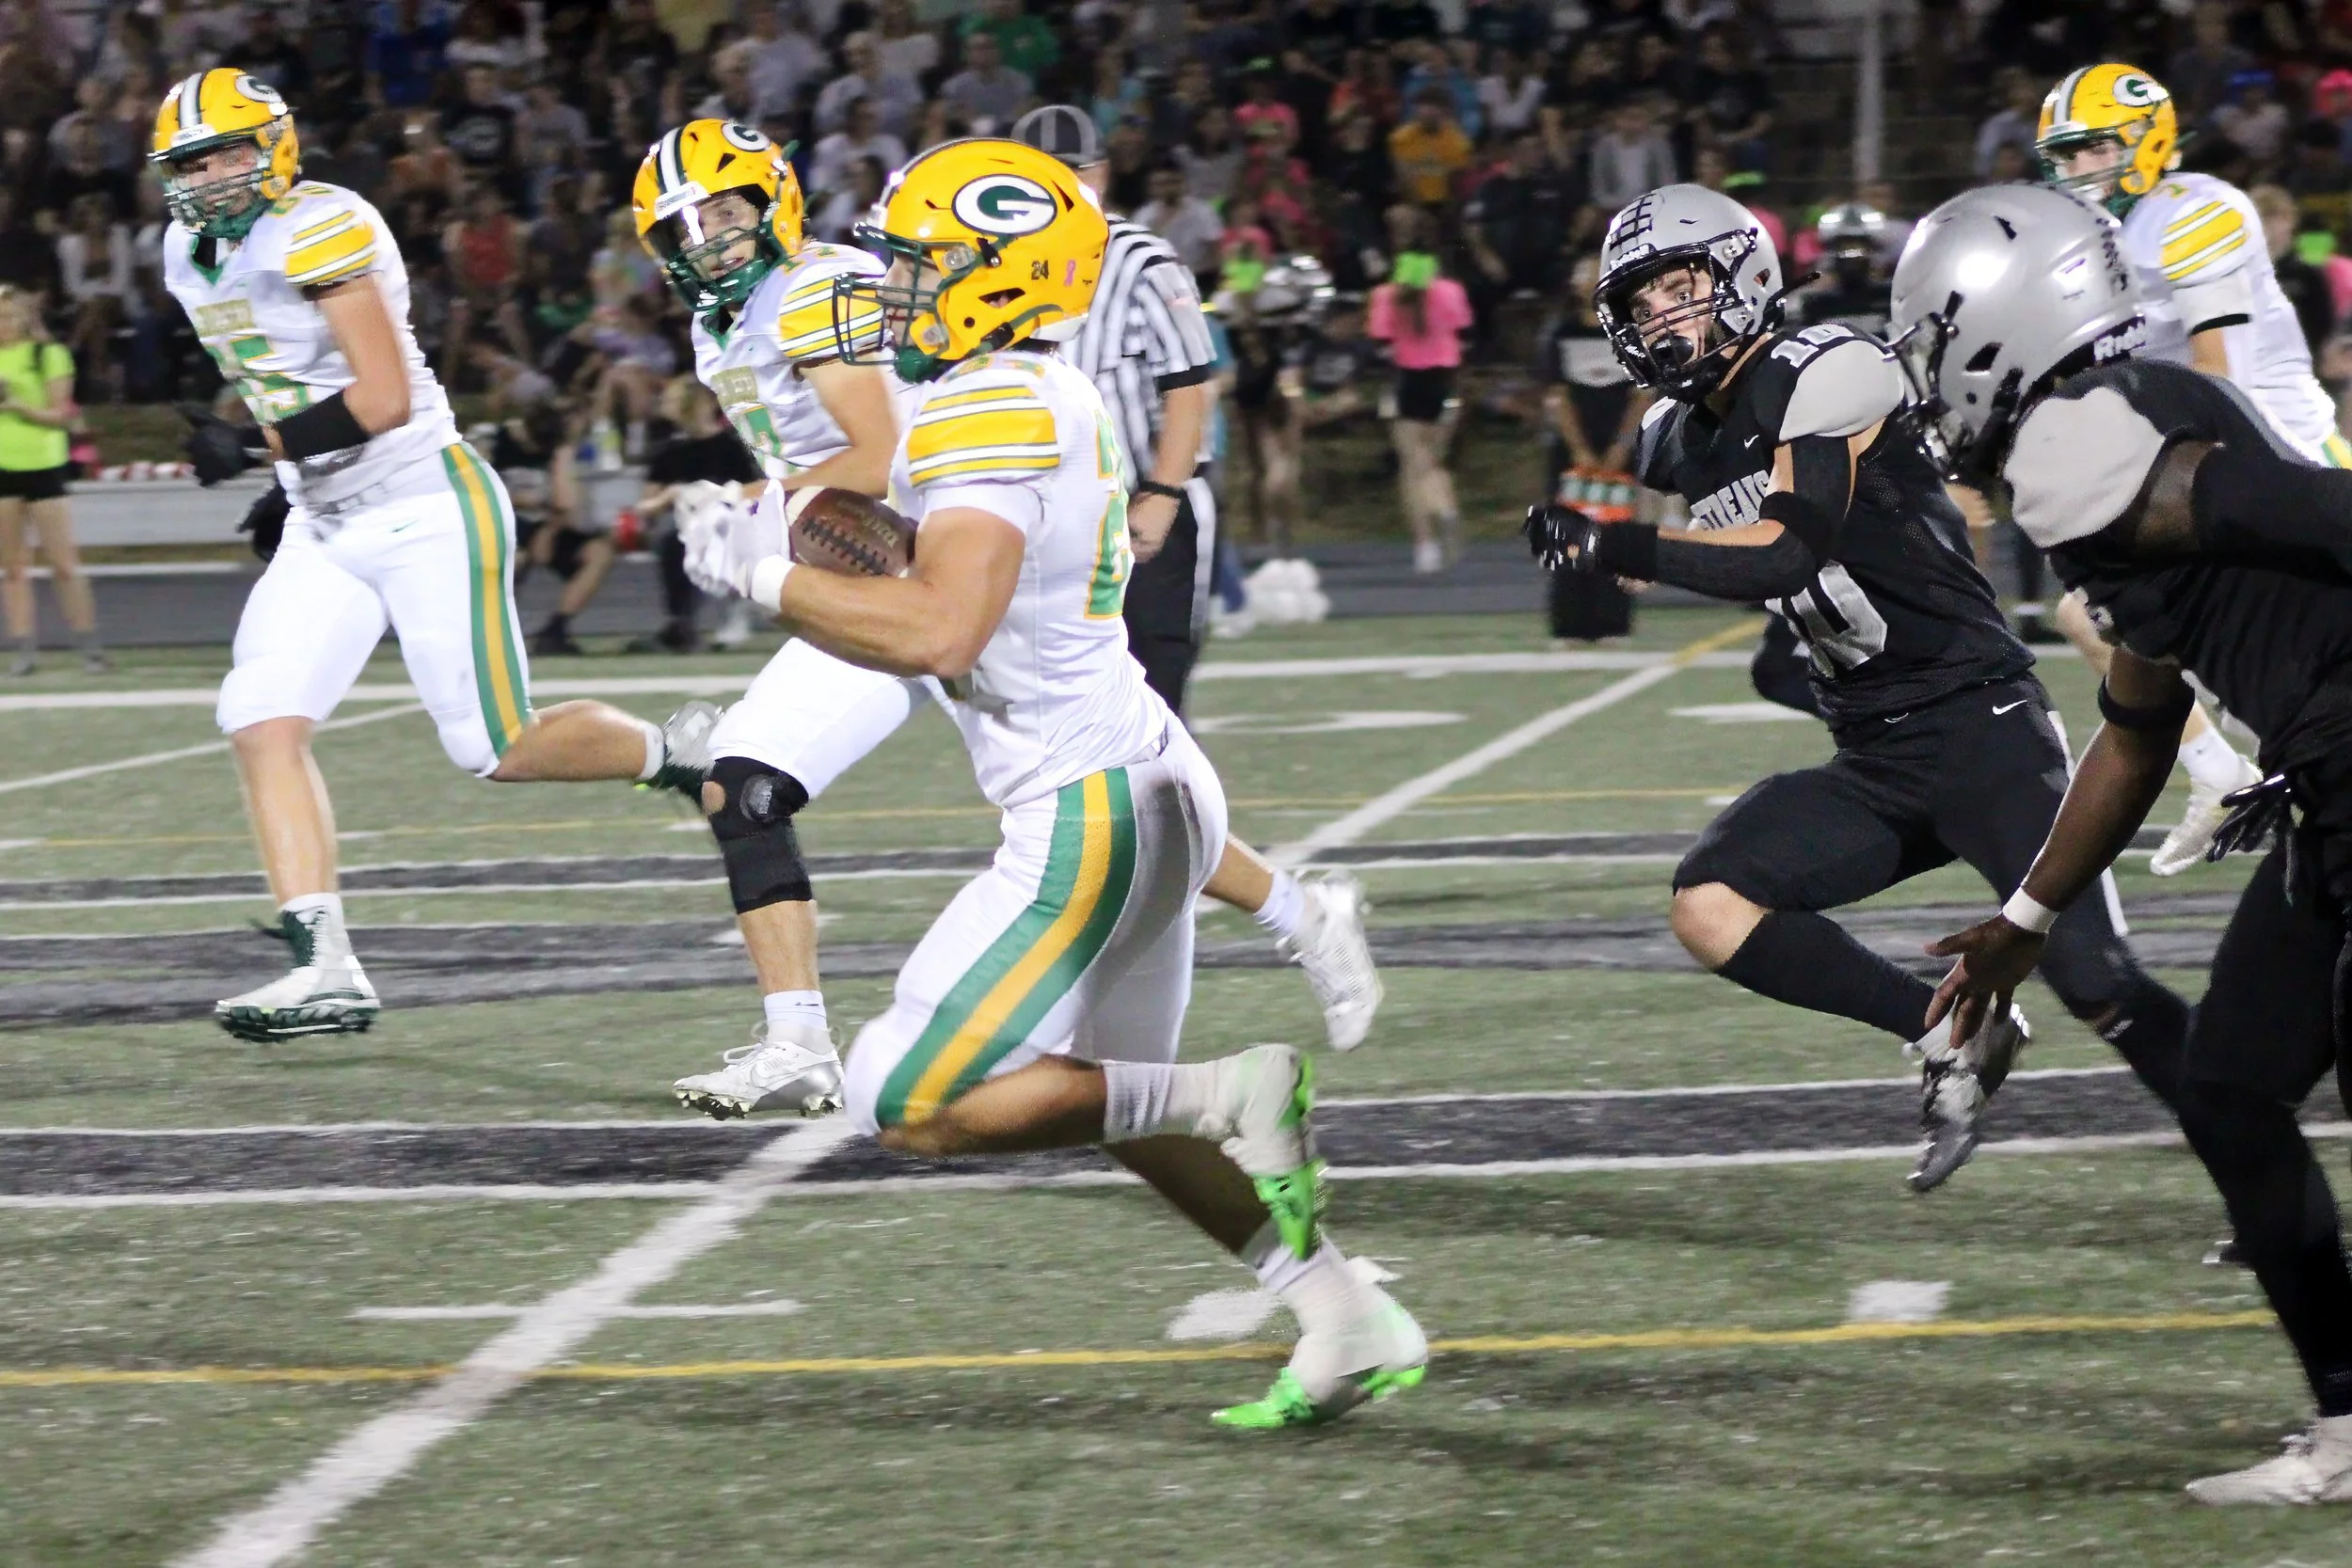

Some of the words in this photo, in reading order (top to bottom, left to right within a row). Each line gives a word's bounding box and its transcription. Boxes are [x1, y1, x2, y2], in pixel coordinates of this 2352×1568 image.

[952, 173, 1057, 235] G
[1031, 260, 1049, 280] 24
[1771, 324, 1854, 368] 10
